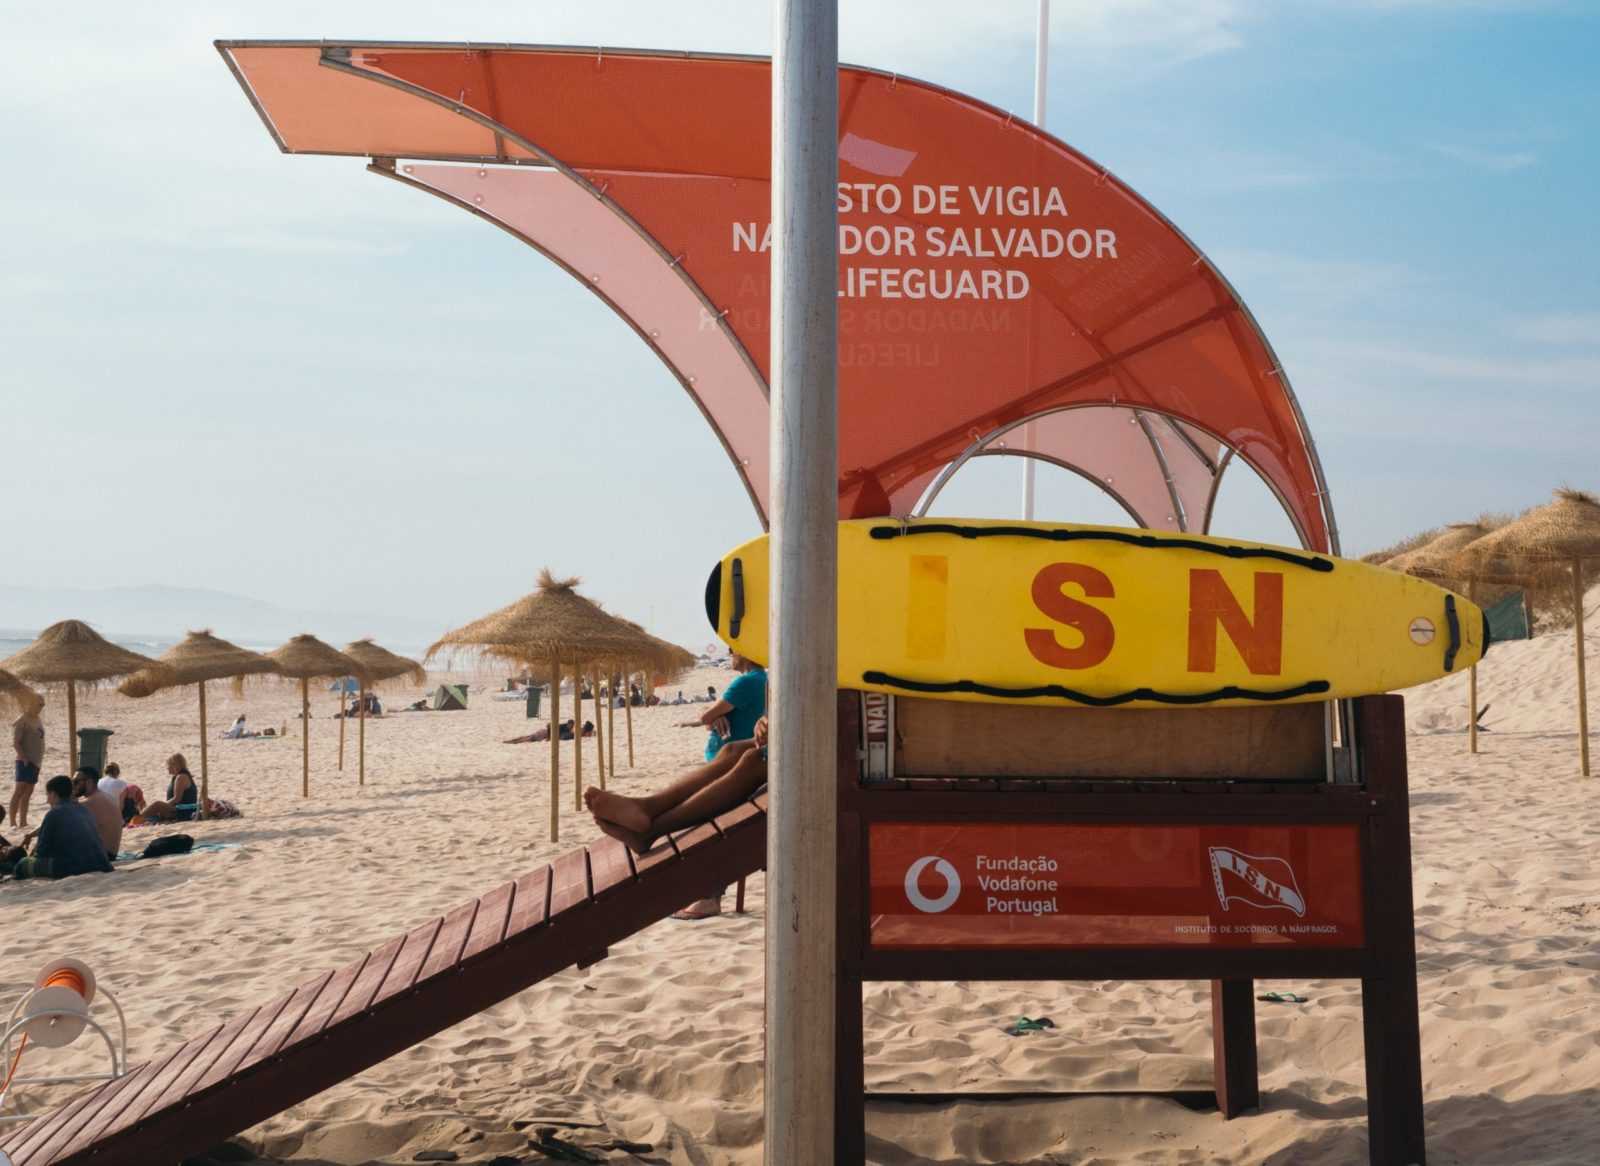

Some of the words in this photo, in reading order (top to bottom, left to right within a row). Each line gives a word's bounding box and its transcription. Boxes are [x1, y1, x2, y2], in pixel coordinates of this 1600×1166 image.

[837, 182, 902, 214] STO
[912, 184, 961, 215] DE
[968, 186, 1068, 217] VIGIA
[732, 222, 917, 257] NDOR
[925, 226, 1118, 259] SALVADOR
[838, 267, 1030, 300] IFEGUARD
[976, 855, 1058, 874] Fundação
[977, 875, 1058, 891] Vodafone
[987, 896, 1058, 917] Portugal
